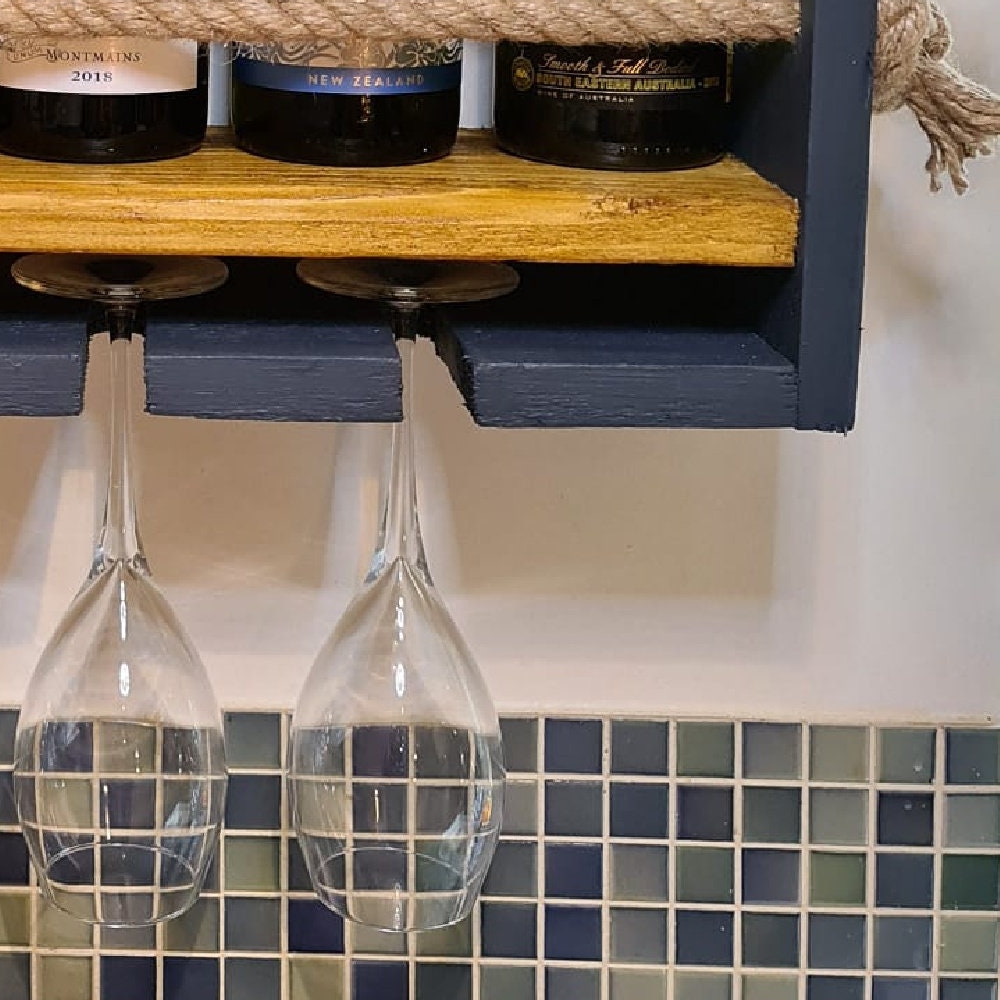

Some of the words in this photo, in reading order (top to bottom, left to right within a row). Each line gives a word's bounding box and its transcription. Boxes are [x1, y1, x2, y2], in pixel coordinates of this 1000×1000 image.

[70, 69, 114, 82] 2018
[308, 74, 344, 86] NEW
[352, 74, 425, 87] ZEALAND
